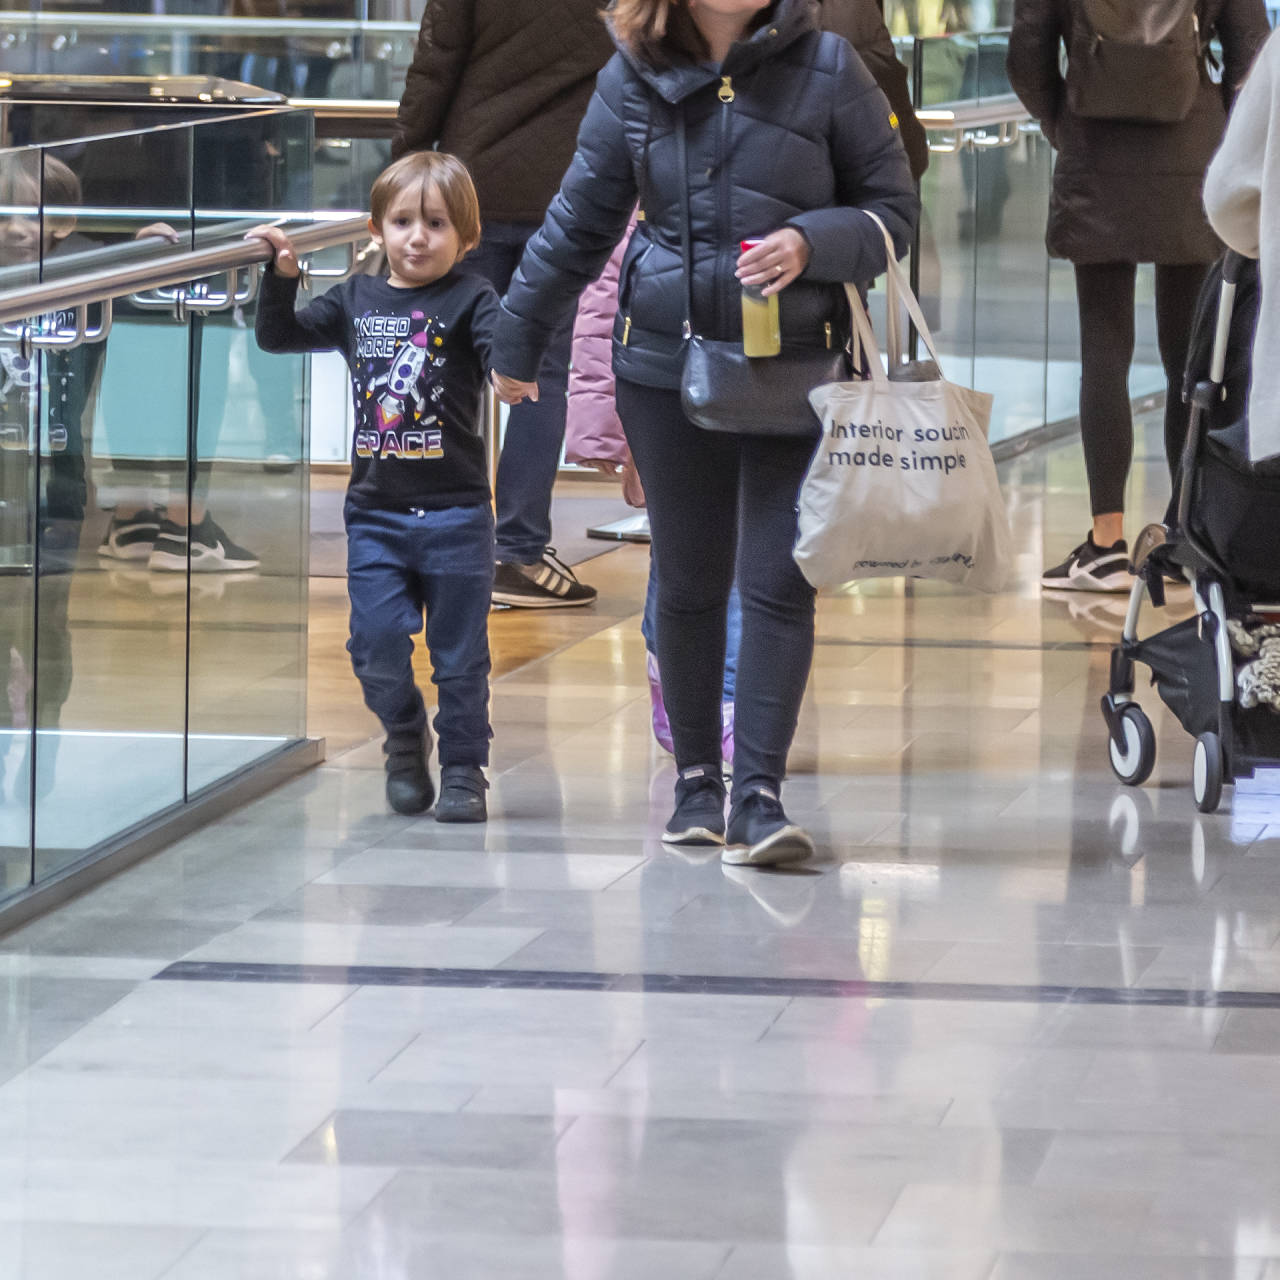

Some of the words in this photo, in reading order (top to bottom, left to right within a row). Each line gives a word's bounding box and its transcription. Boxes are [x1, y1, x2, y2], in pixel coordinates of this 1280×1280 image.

[360, 317, 411, 337] NEED
[830, 420, 904, 443] Interior
[356, 429, 444, 460] SPACE
[829, 445, 894, 467] made
